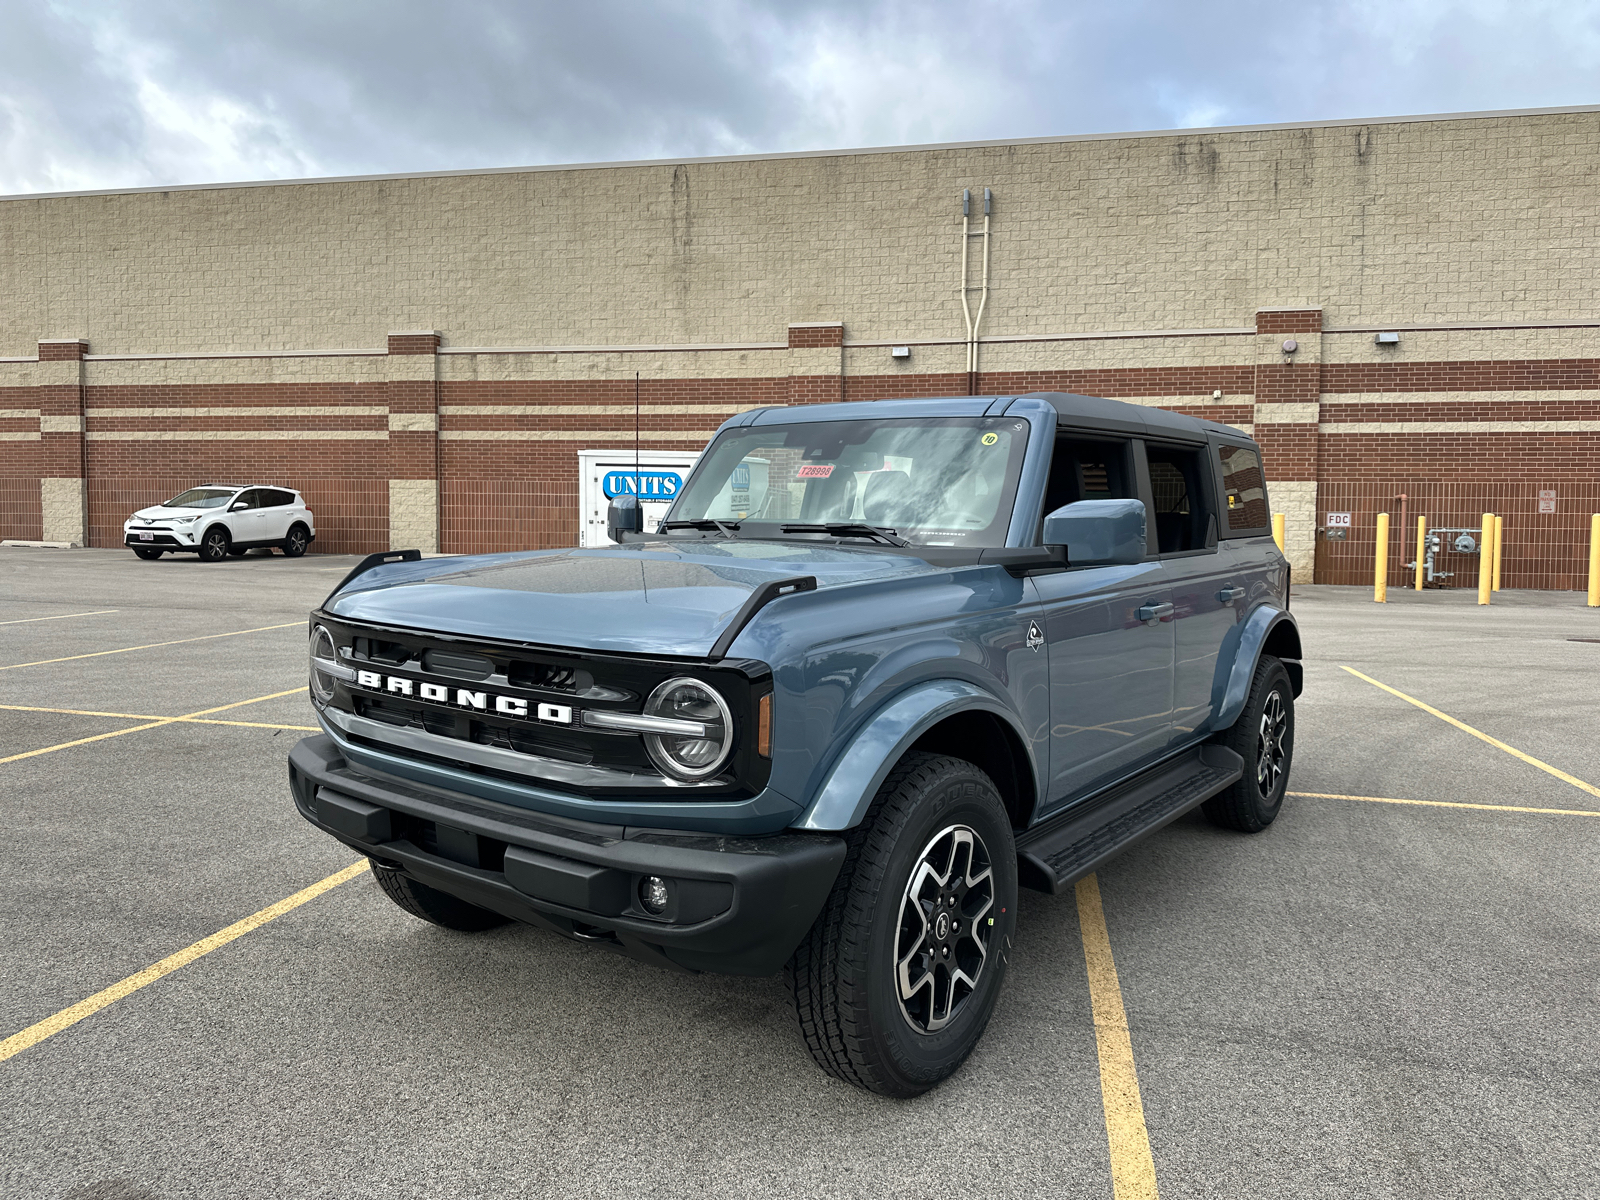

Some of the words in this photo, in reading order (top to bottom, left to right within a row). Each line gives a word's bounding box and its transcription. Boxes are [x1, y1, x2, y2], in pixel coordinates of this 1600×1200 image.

[984, 434, 996, 444] 10
[801, 466, 832, 476] T28998
[608, 475, 677, 495] UNITS
[1328, 515, 1349, 524] FDC
[357, 670, 573, 724] BRONCO
